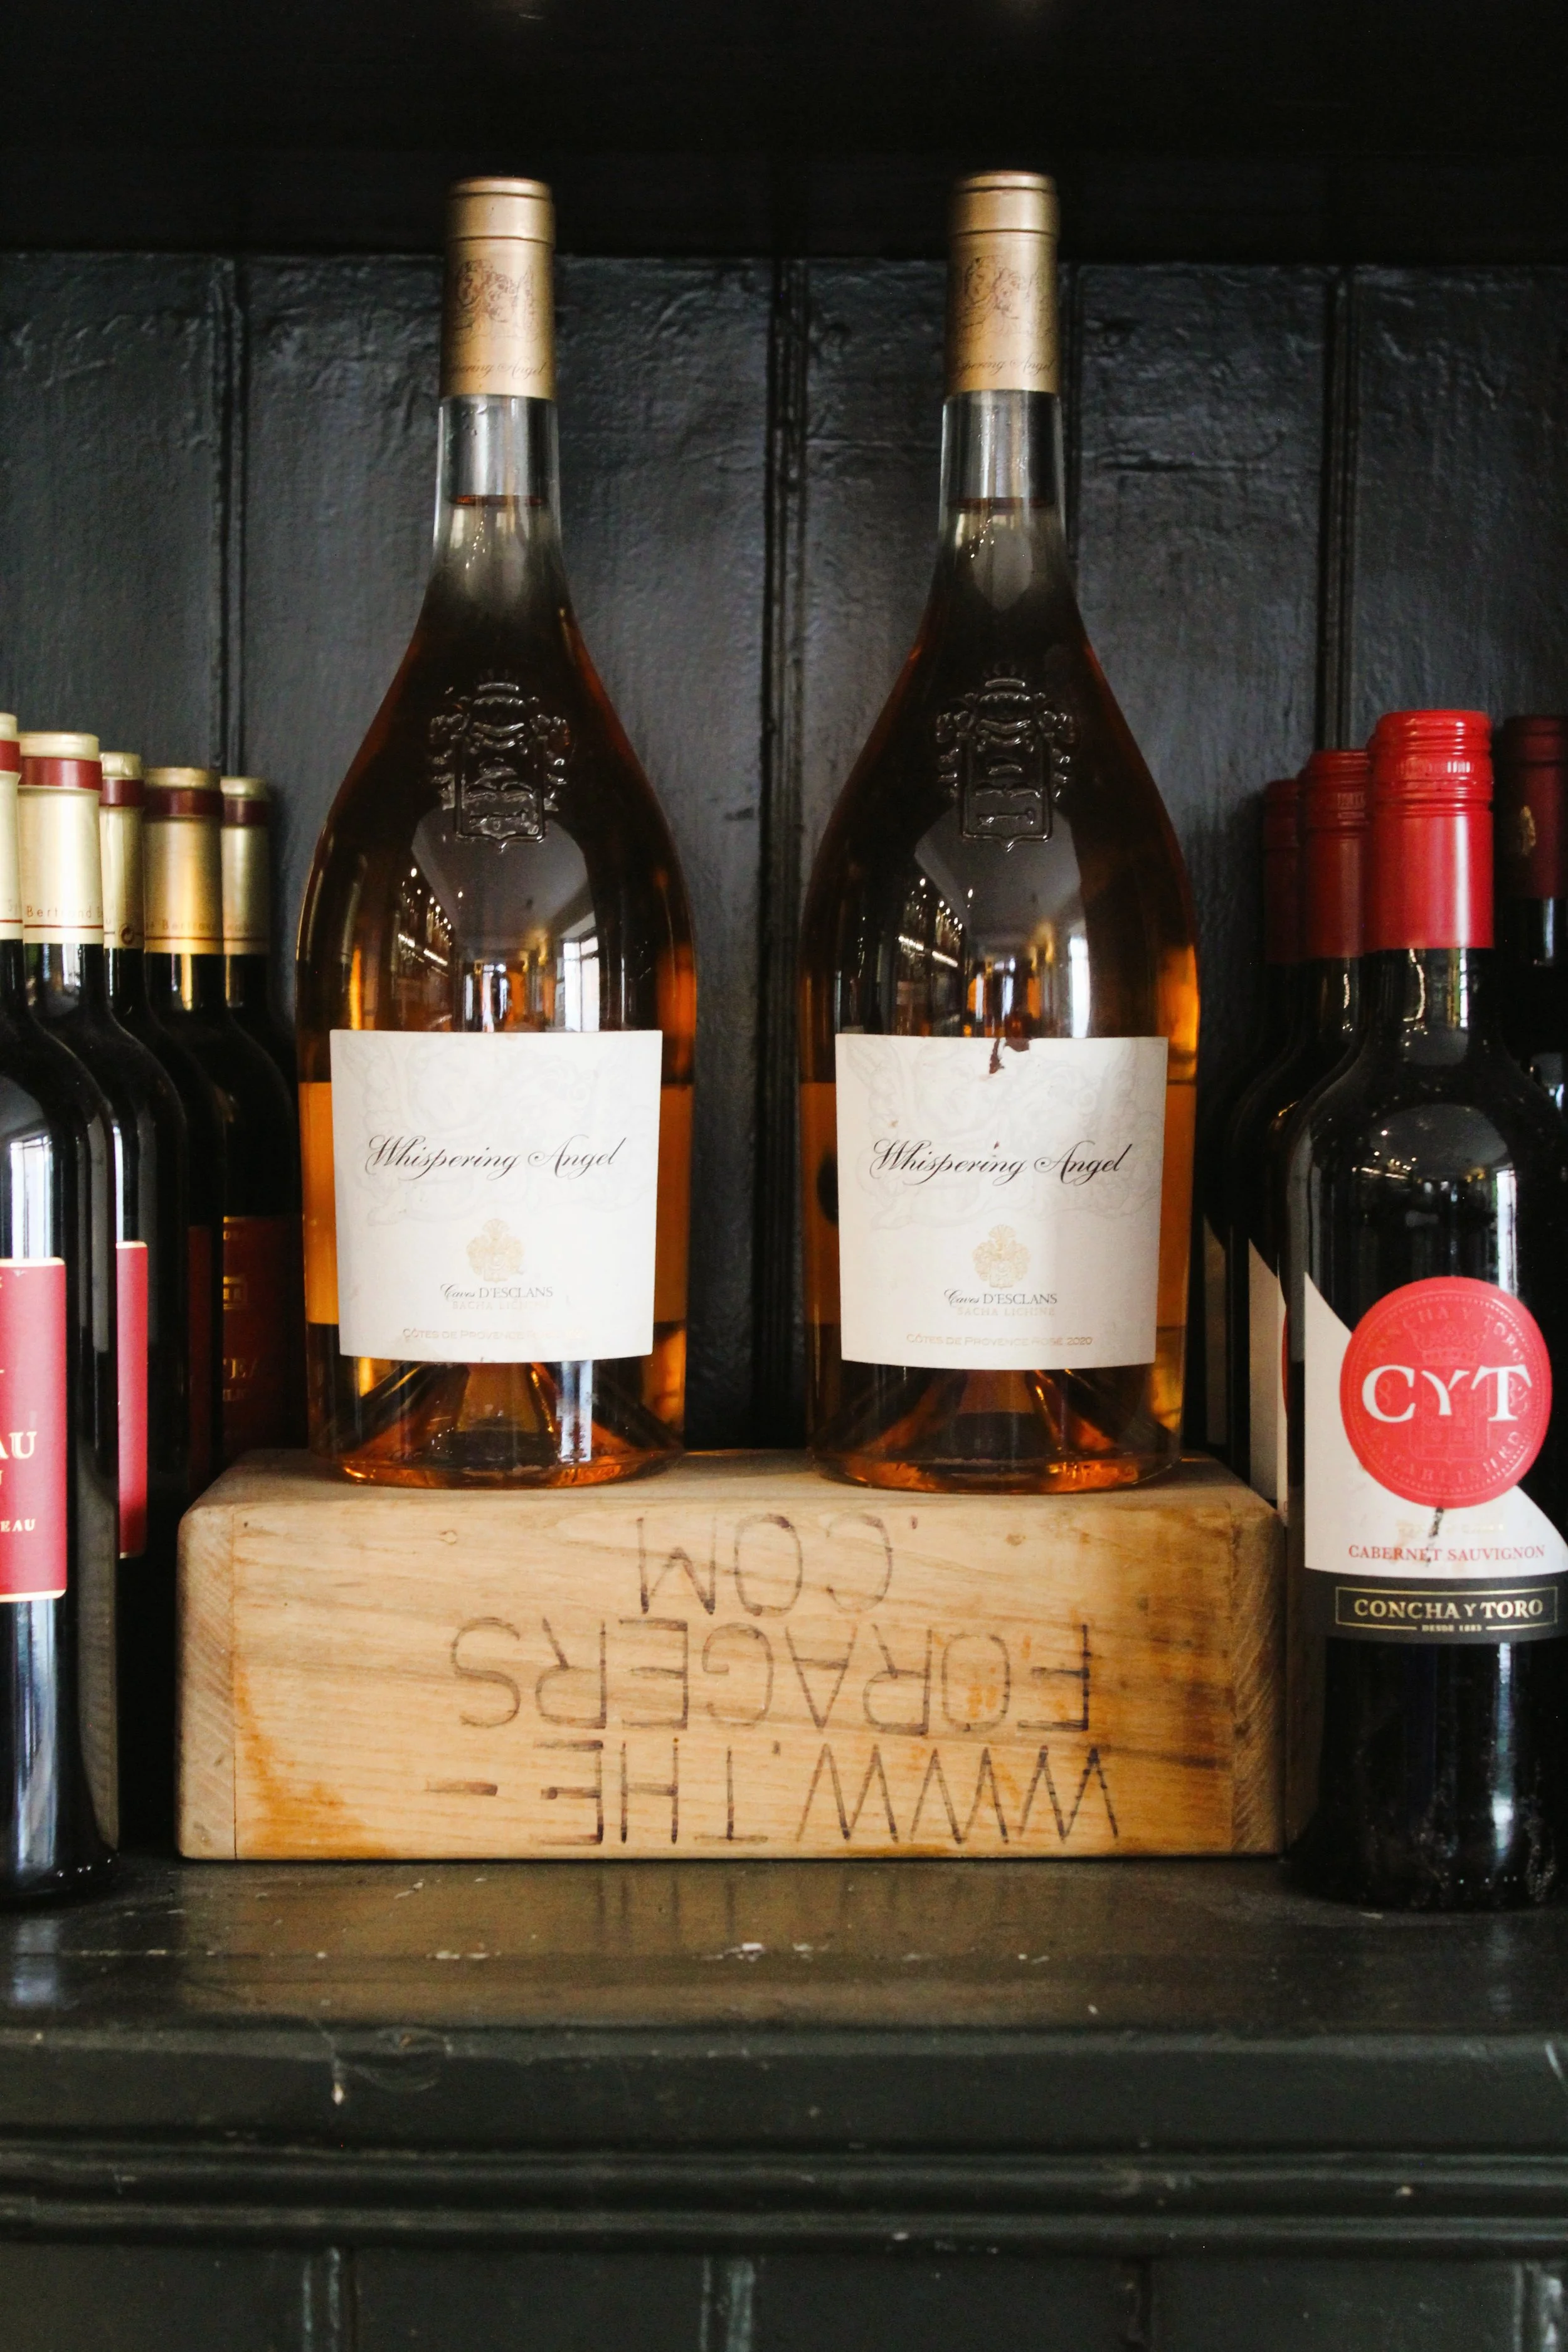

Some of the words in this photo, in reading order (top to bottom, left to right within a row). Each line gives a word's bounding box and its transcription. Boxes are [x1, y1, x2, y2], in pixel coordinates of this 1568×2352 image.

[26, 905, 92, 918] Bertnd
[365, 1135, 522, 1181] Whispering
[528, 1134, 626, 1180] Angel
[870, 1140, 1029, 1185] Whispering
[1034, 1140, 1133, 1186] Angel
[440, 1283, 477, 1302] Caves
[479, 1286, 553, 1299] D'ESCLANS
[944, 1288, 980, 1308] Caves
[983, 1293, 1058, 1305] D'ESCLANS
[499, 1301, 550, 1311] LICH
[957, 1307, 999, 1316] SACHA
[1004, 1307, 1055, 1316] LICHINE
[442, 1330, 458, 1340] DE
[906, 1333, 943, 1345] CÔTES
[946, 1336, 962, 1345] DE
[964, 1336, 1029, 1347] PROVENCE
[1066, 1336, 1094, 1346] 2020
[1361, 1364, 1533, 1424] CYT
[1348, 1545, 1443, 1562] CABERNET
[1447, 1544, 1546, 1562] SAUVIGNON
[1353, 1599, 1461, 1619] CONCHA
[1463, 1603, 1477, 1618] Y
[1479, 1599, 1544, 1619] TORO
[450, 1616, 1091, 1736] FORAGERS
